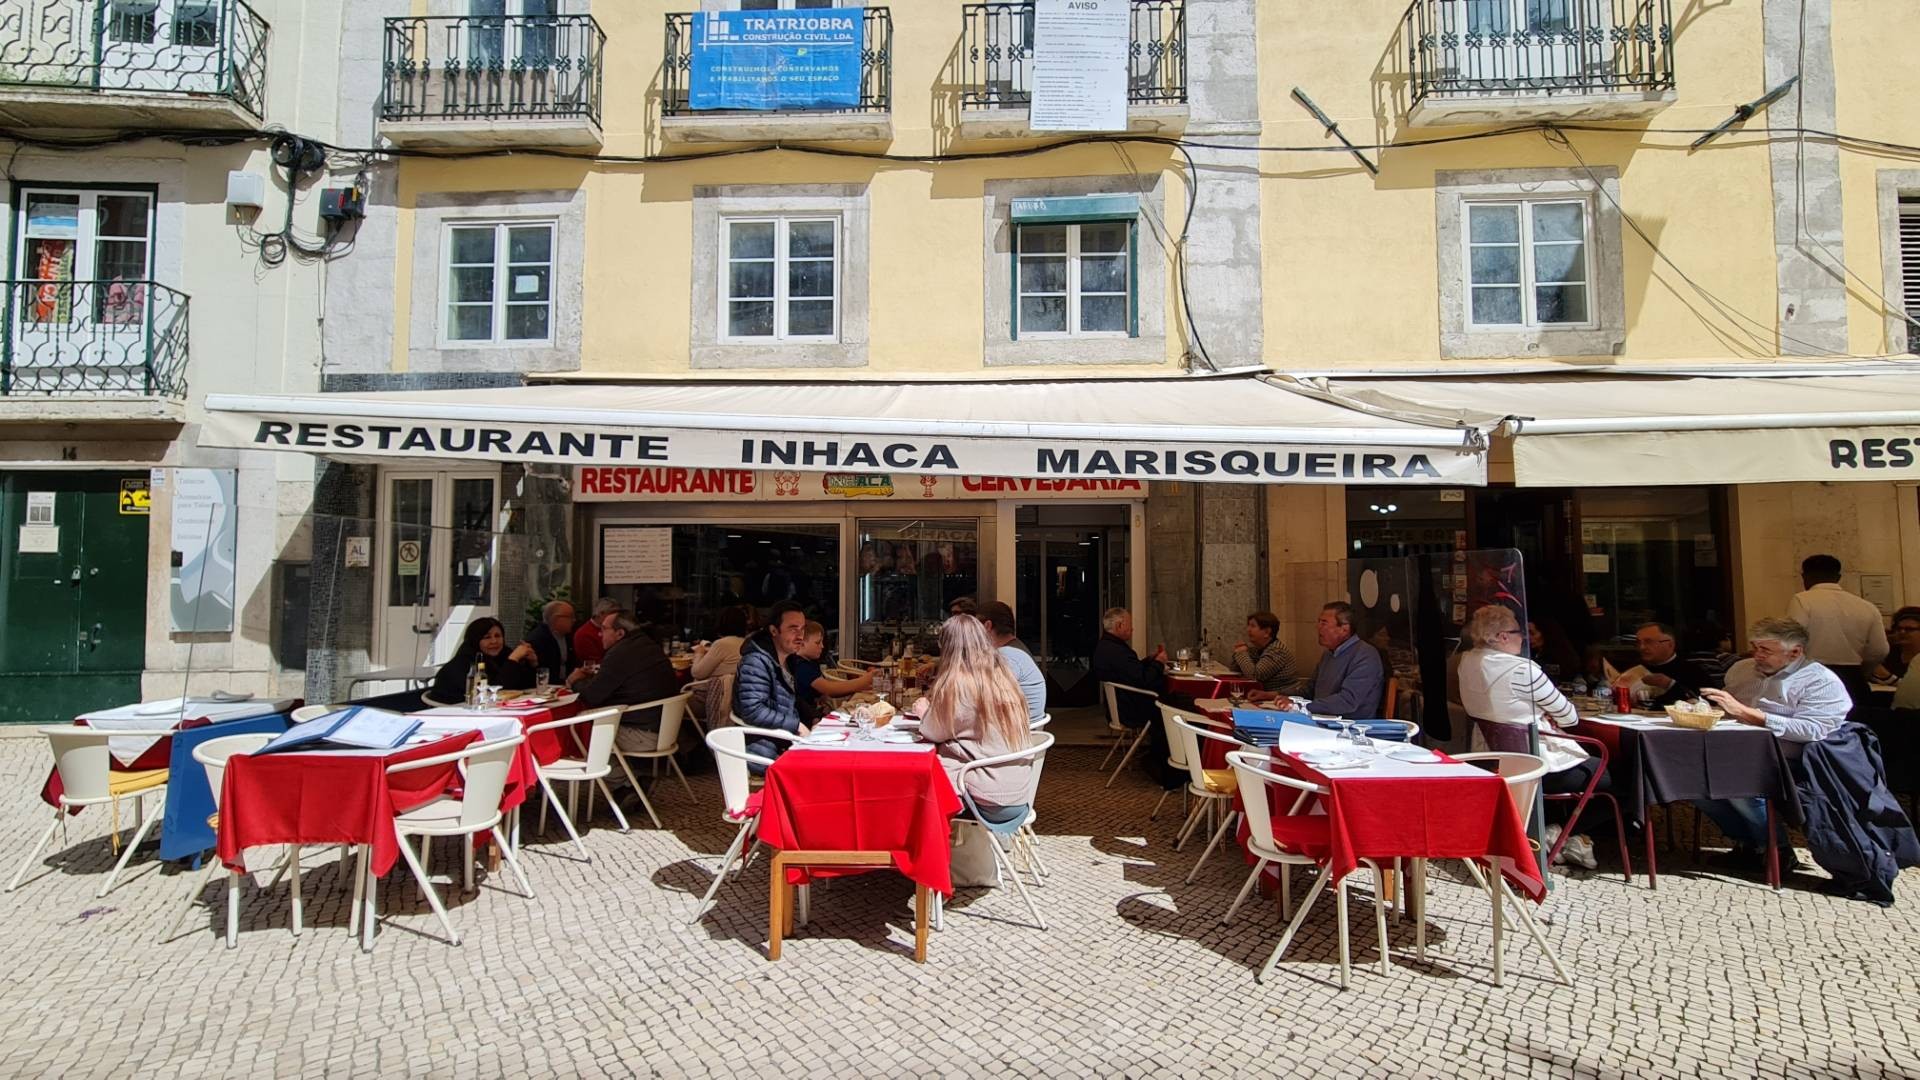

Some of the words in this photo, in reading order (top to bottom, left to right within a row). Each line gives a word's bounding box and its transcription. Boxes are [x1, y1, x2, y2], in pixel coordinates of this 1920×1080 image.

[1068, 2, 1098, 10] AVISO
[744, 18, 854, 31] TRATRIOBRA
[743, 32, 802, 42] CONSTRUÇÃO
[808, 75, 840, 83] ESPAÇO
[254, 421, 669, 460] RESTAURANTE
[741, 439, 959, 469] INHACA
[1036, 448, 1442, 478] MARISQUEIRA
[581, 467, 755, 494] RESTAURANTE
[352, 545, 366, 556] AL
